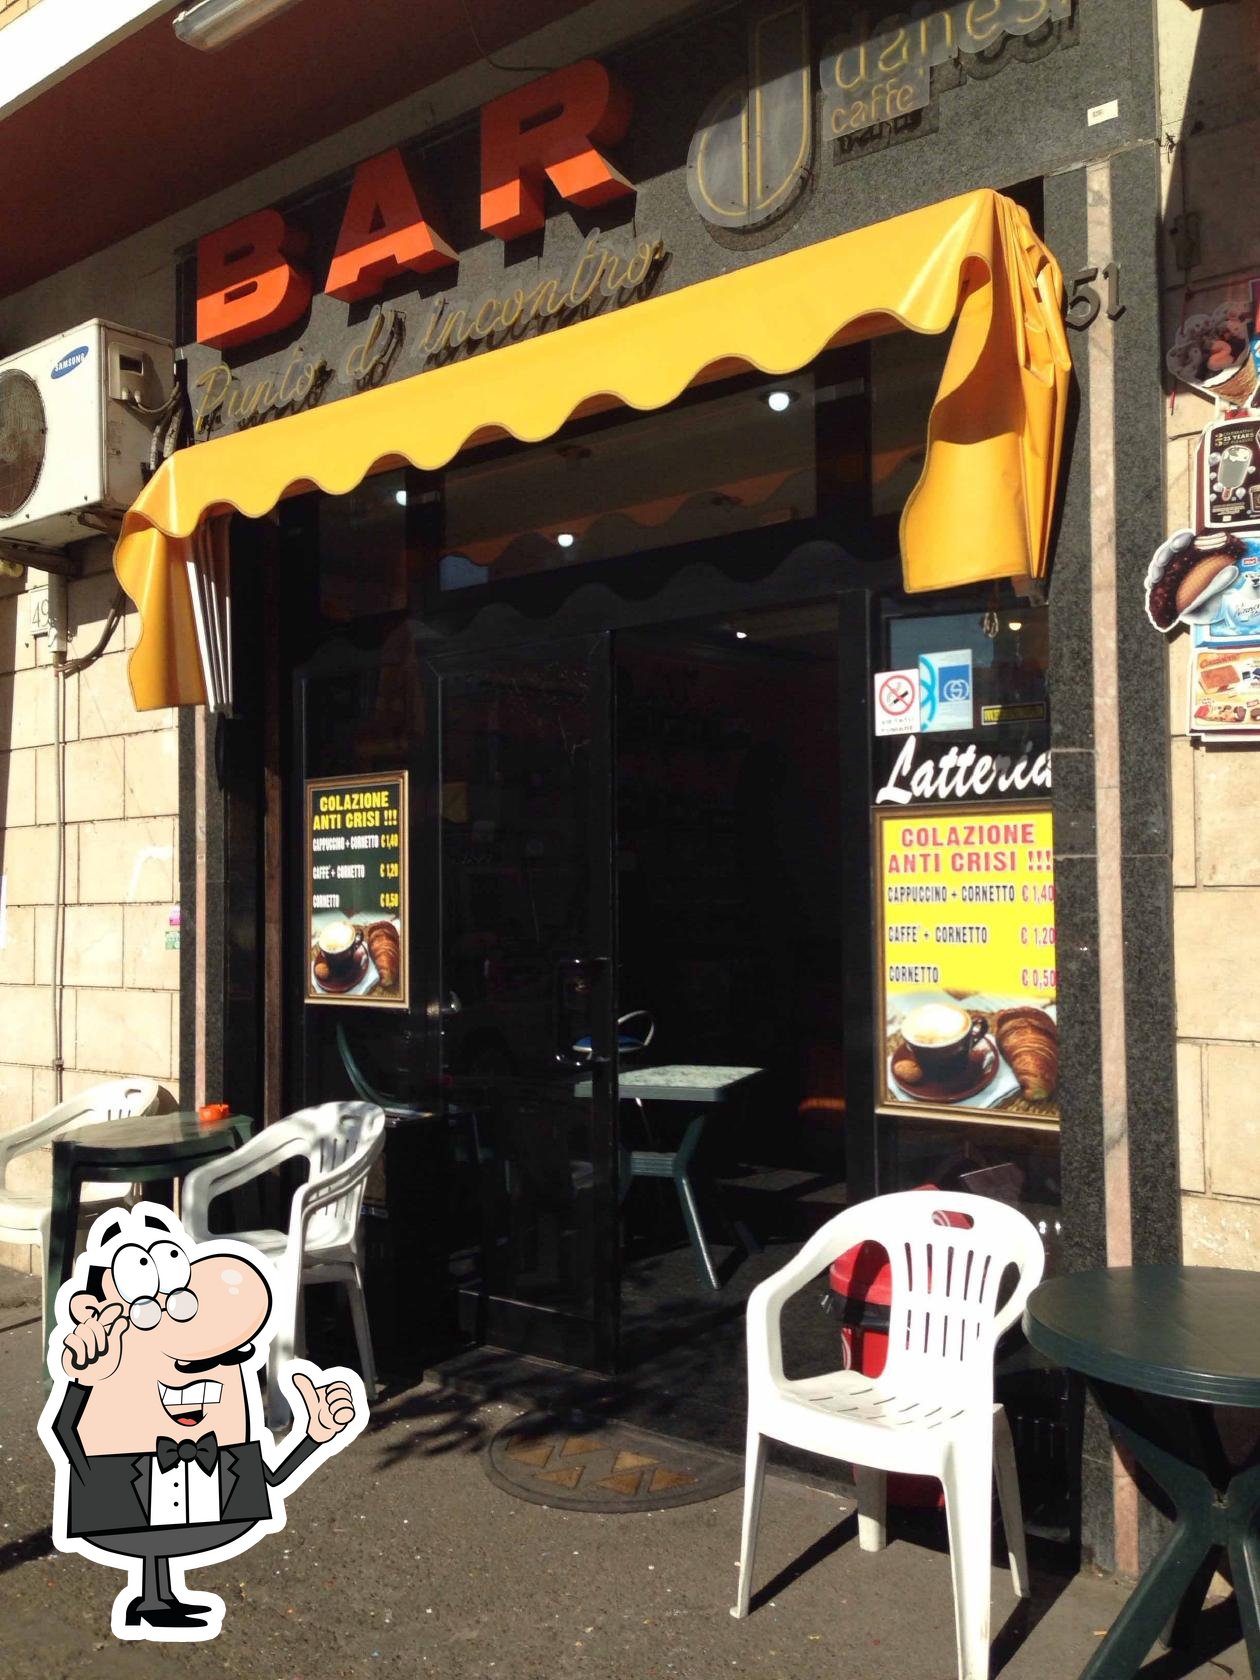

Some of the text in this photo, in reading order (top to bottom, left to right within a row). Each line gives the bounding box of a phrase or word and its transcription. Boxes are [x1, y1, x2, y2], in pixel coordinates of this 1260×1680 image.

[196, 58, 638, 350] BAR
[1066, 263, 1126, 331] 51
[194, 344, 331, 434] Punto
[418, 237, 668, 358] incontro
[54, 352, 86, 372] SAMSUNG
[319, 791, 389, 812] COLAZIONE
[313, 809, 397, 830] ANTI CRISI !!!
[901, 824, 1035, 847] COLAZIONE
[888, 850, 1052, 873] ANTI CRISI !!!
[887, 886, 947, 903] CAPPUCCINO
[961, 885, 1015, 902] CORNETTO
[935, 926, 988, 944] CORNETTO
[889, 965, 939, 983] CORNETTO
